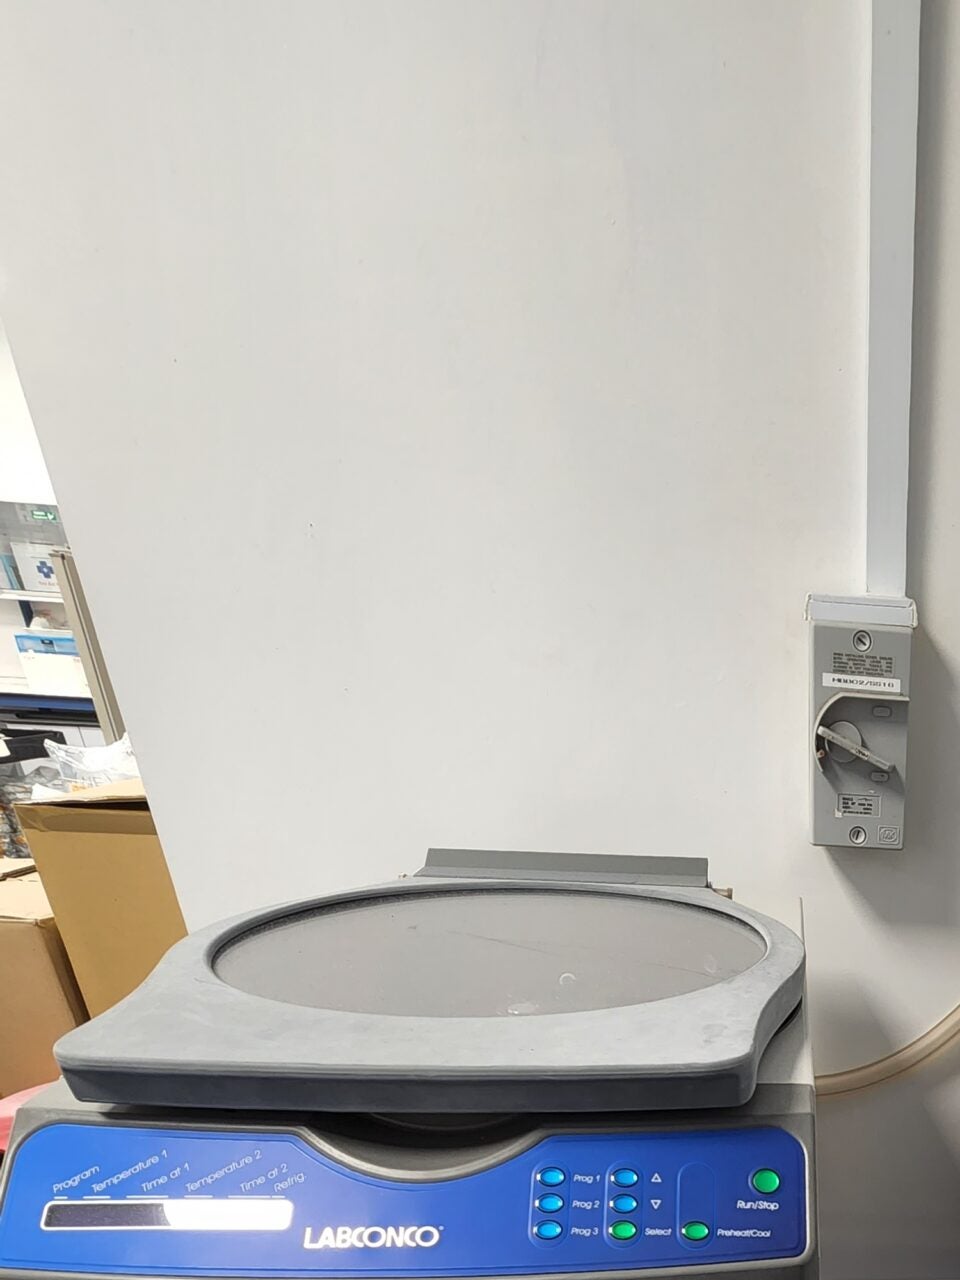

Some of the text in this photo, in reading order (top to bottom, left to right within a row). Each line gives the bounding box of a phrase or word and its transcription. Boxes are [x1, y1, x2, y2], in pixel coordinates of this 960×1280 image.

[53, 1165, 101, 1194] Program
[91, 1149, 168, 1194] Temperature 1
[141, 1162, 190, 1192] Time at 1
[185, 1150, 263, 1193] Temperature 2
[239, 1163, 289, 1193] Time at 2
[574, 1174, 601, 1184] Prog 1
[273, 1172, 307, 1193] Refrig.
[572, 1200, 600, 1210] Prog 2
[736, 1200, 780, 1211] Run/Stop
[304, 1226, 440, 1249] LABCONCO
[570, 1227, 599, 1237] Prog 3
[644, 1227, 672, 1236] Select
[717, 1228, 771, 1238] Preheat/Cool
